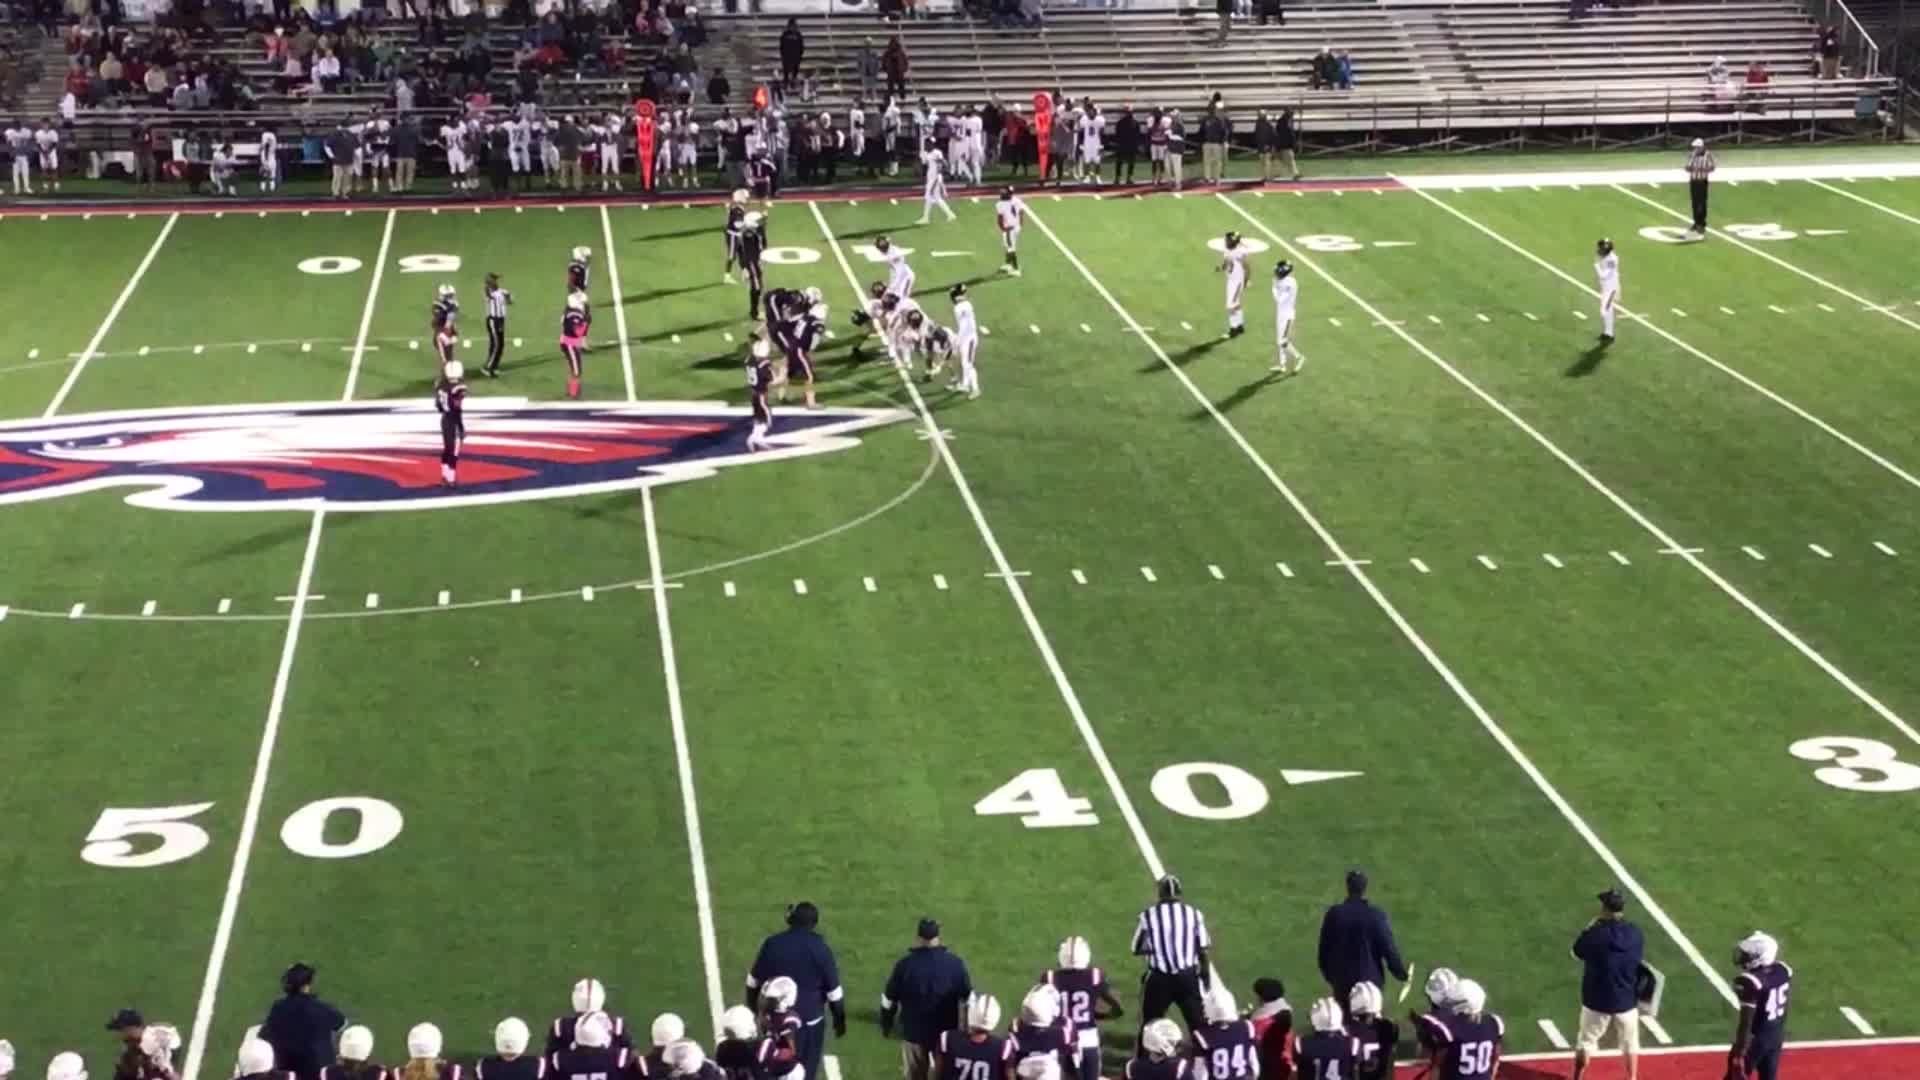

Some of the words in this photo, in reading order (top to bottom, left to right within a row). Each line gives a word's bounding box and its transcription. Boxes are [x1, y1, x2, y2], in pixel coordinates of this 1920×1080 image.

[973, 762, 1271, 829] 40
[80, 796, 404, 868] 50
[1060, 990, 1091, 1023] 12
[1765, 982, 1790, 1021] 45
[955, 1057, 991, 1080] 70
[1212, 1043, 1247, 1080] 84
[1459, 1040, 1494, 1076] 50
